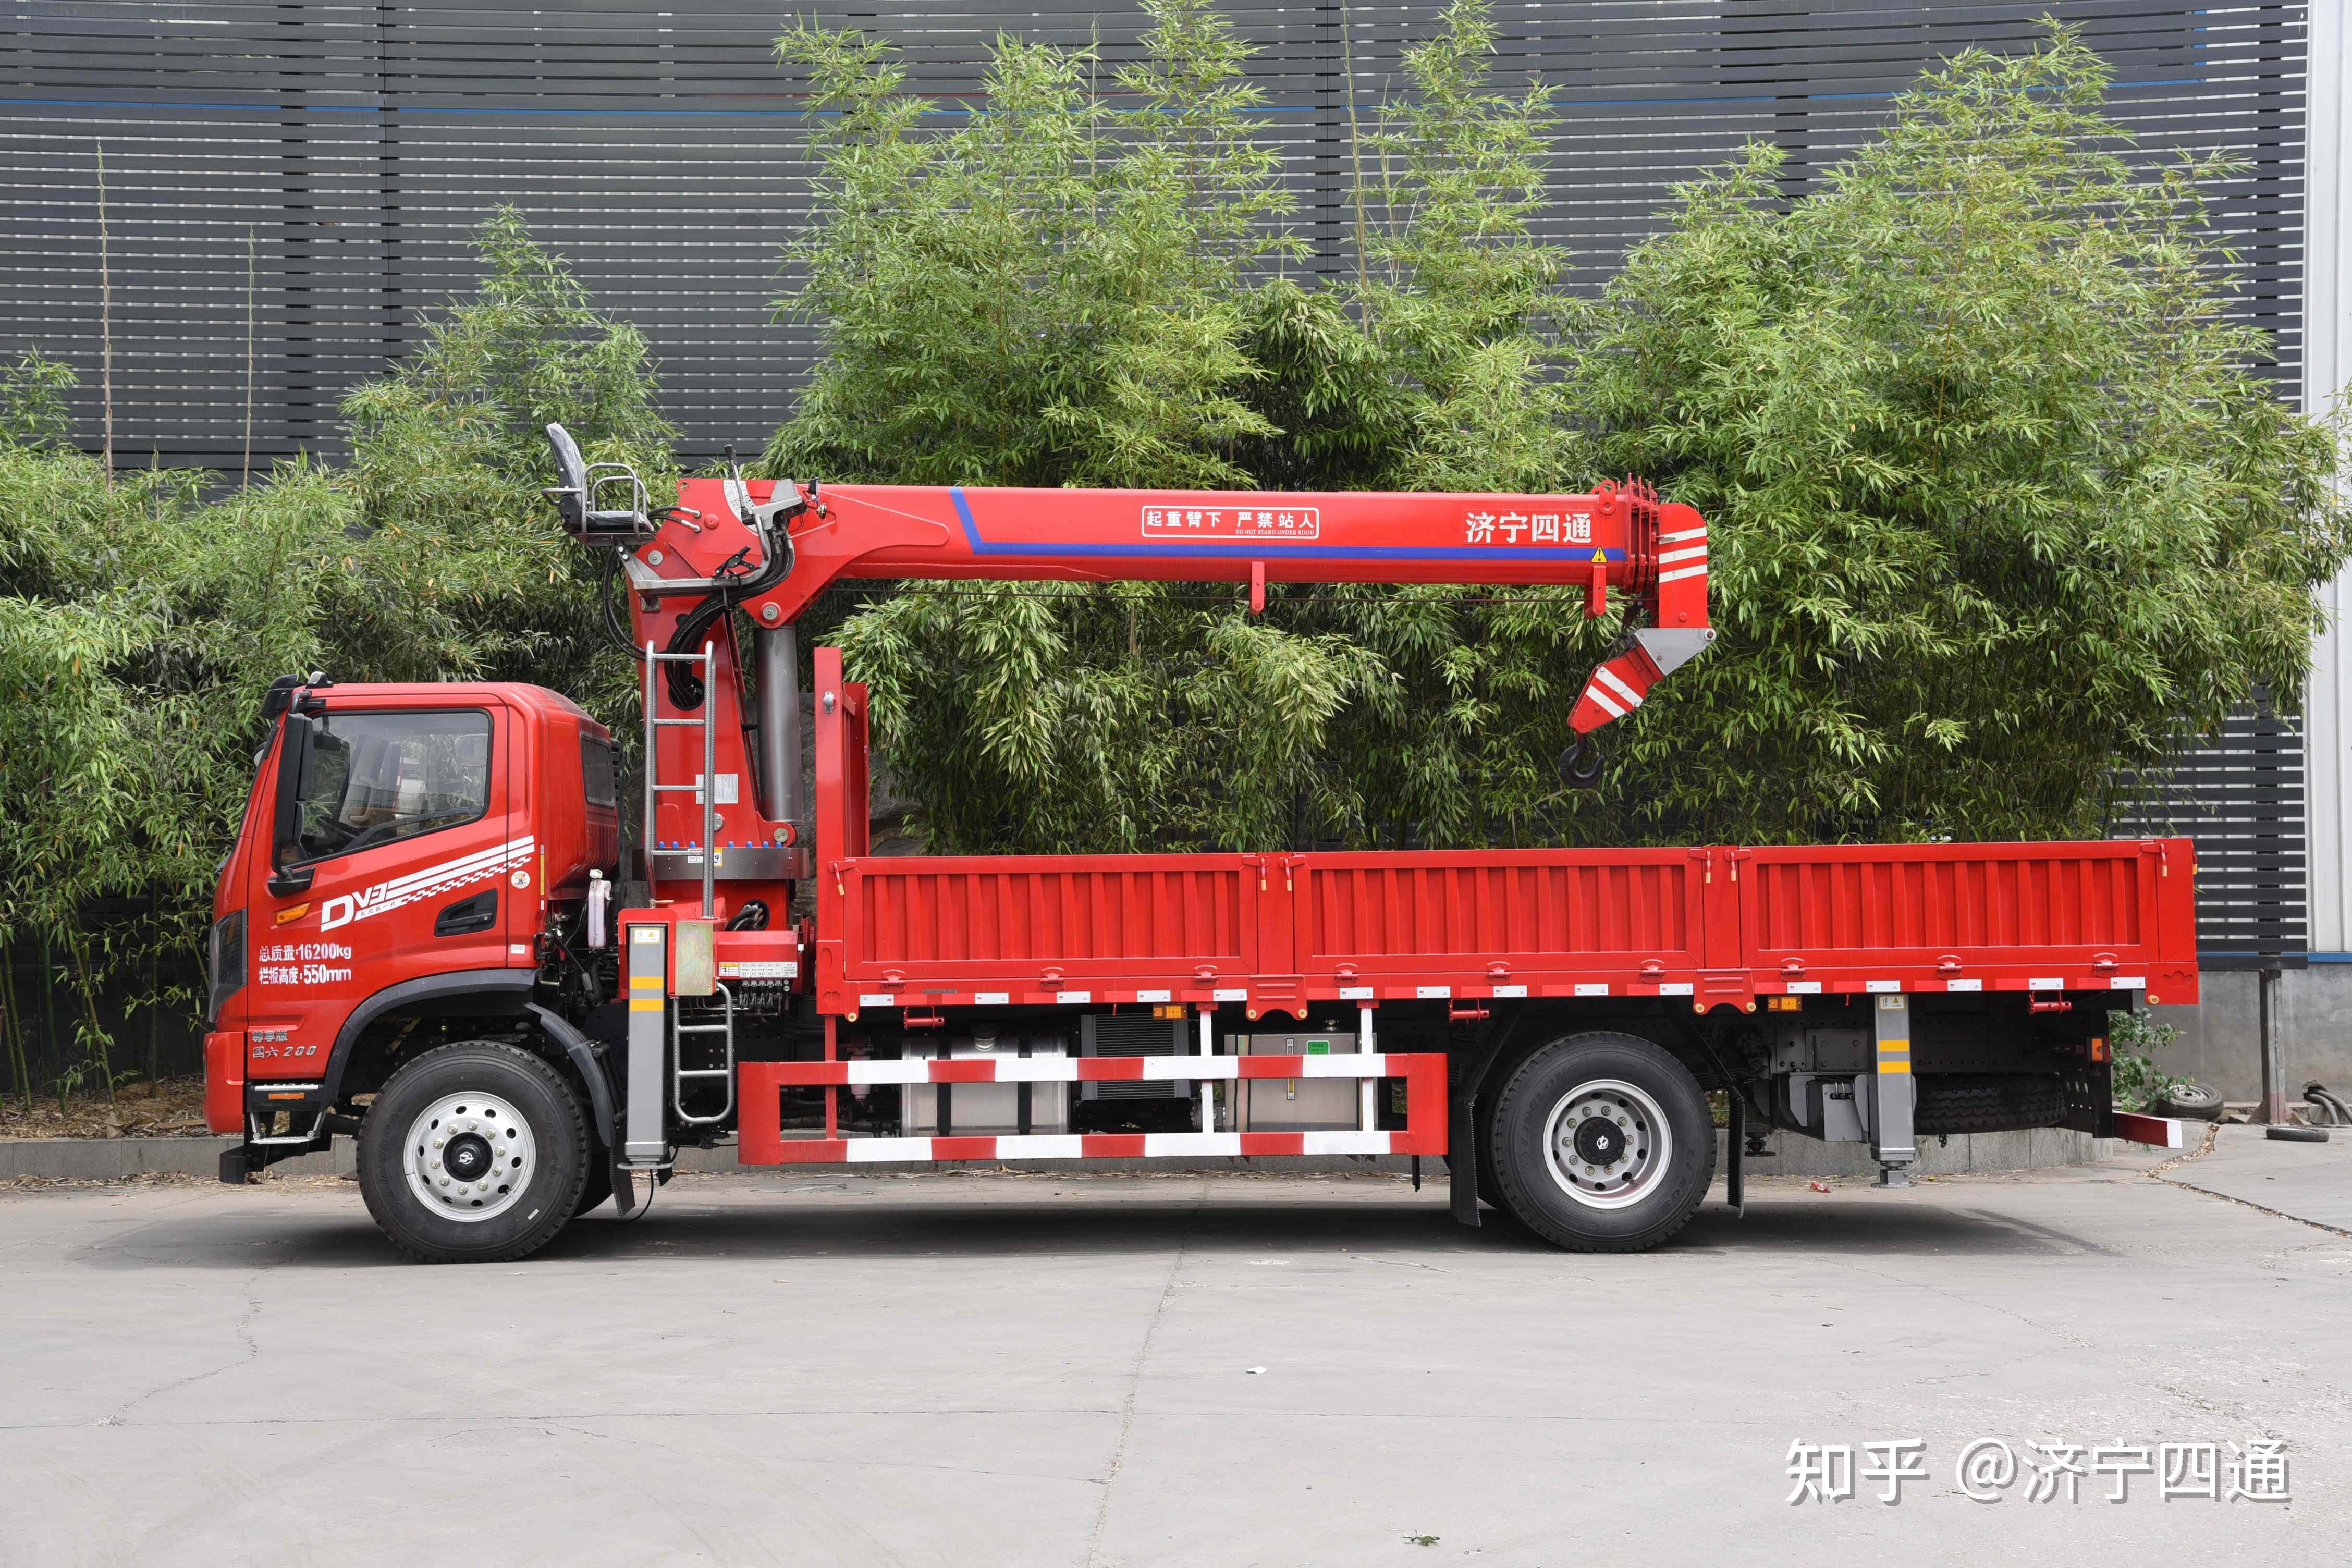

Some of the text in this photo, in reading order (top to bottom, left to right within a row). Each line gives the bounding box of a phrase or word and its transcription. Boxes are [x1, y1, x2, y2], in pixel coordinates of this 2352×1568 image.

[1147, 511, 1314, 528] 起重臂下 严禁站人
[1466, 511, 1592, 543] 济宁四通
[252, 1046, 317, 1058] 国六 200
